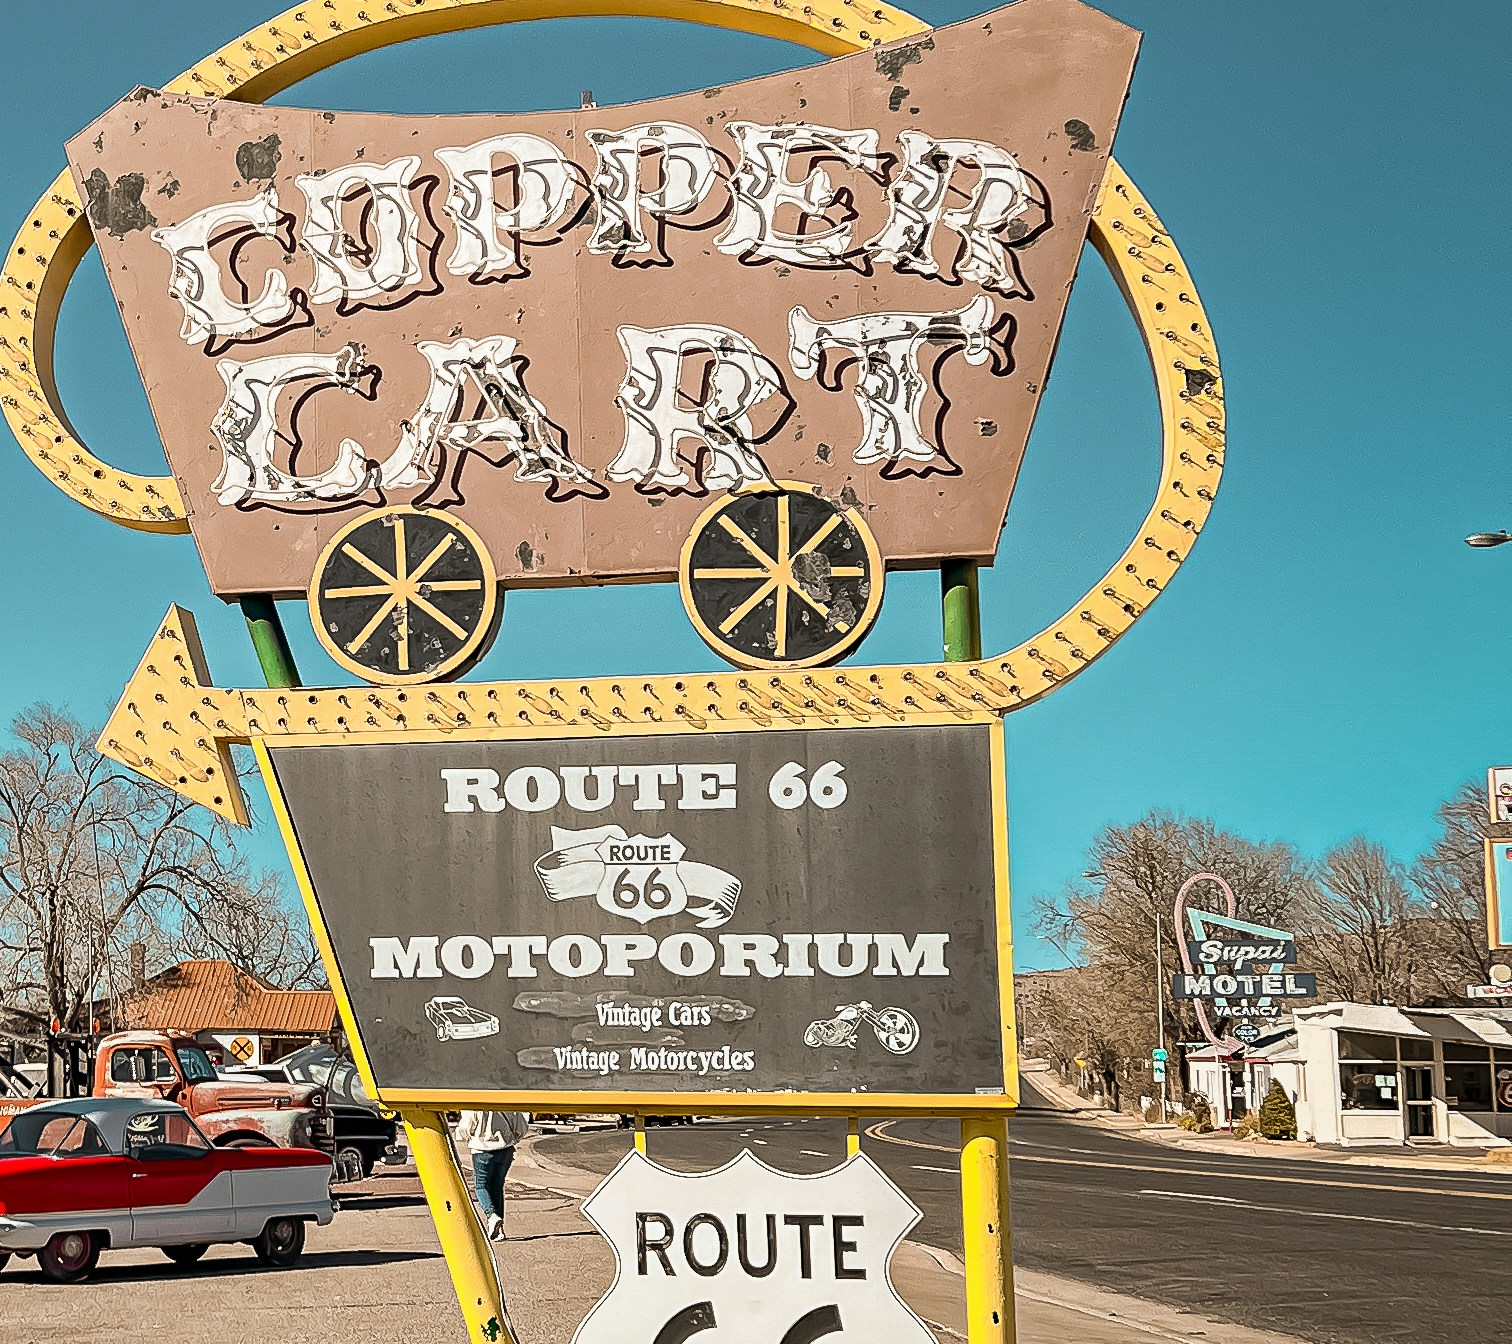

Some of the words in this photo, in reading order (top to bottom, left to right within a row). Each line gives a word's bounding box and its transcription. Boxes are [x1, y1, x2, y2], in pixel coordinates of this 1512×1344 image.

[152, 121, 1052, 355] COPPER
[209, 294, 1016, 513] CART
[440, 762, 738, 813] ROUTE
[768, 760, 848, 810] 66
[609, 843, 672, 863] ROUTE
[612, 867, 671, 911] 66
[369, 932, 950, 980] MOTOPORIUM
[1198, 940, 1287, 970] Supai
[1184, 974, 1307, 995] MOTEL
[596, 1002, 662, 1032] Vintage
[669, 1002, 711, 1026] Cars
[1213, 1006, 1279, 1017] VACANCY
[553, 1046, 620, 1076] Vintage
[630, 1046, 755, 1076] Motorcycles
[635, 1211, 867, 1280] ROUTE
